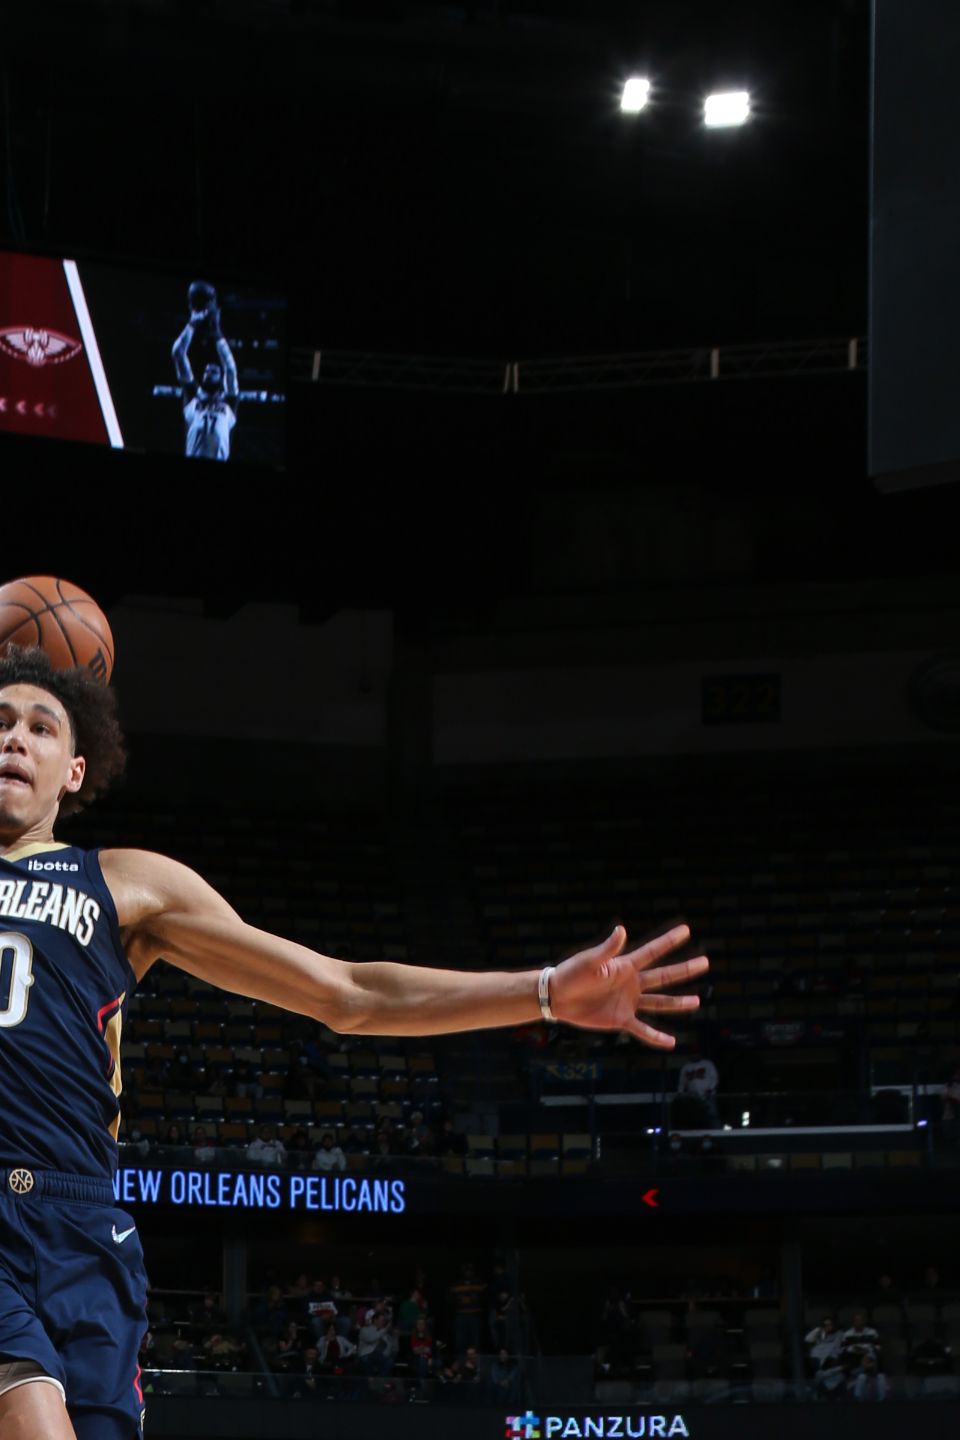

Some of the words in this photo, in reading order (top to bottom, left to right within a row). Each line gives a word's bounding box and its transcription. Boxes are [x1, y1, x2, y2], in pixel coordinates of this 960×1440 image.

[27, 860, 79, 872] ibotta
[170, 1170, 281, 1208] ORLEANS
[289, 1175, 406, 1213] PELICANS
[545, 1414, 690, 1438] PANZURA
